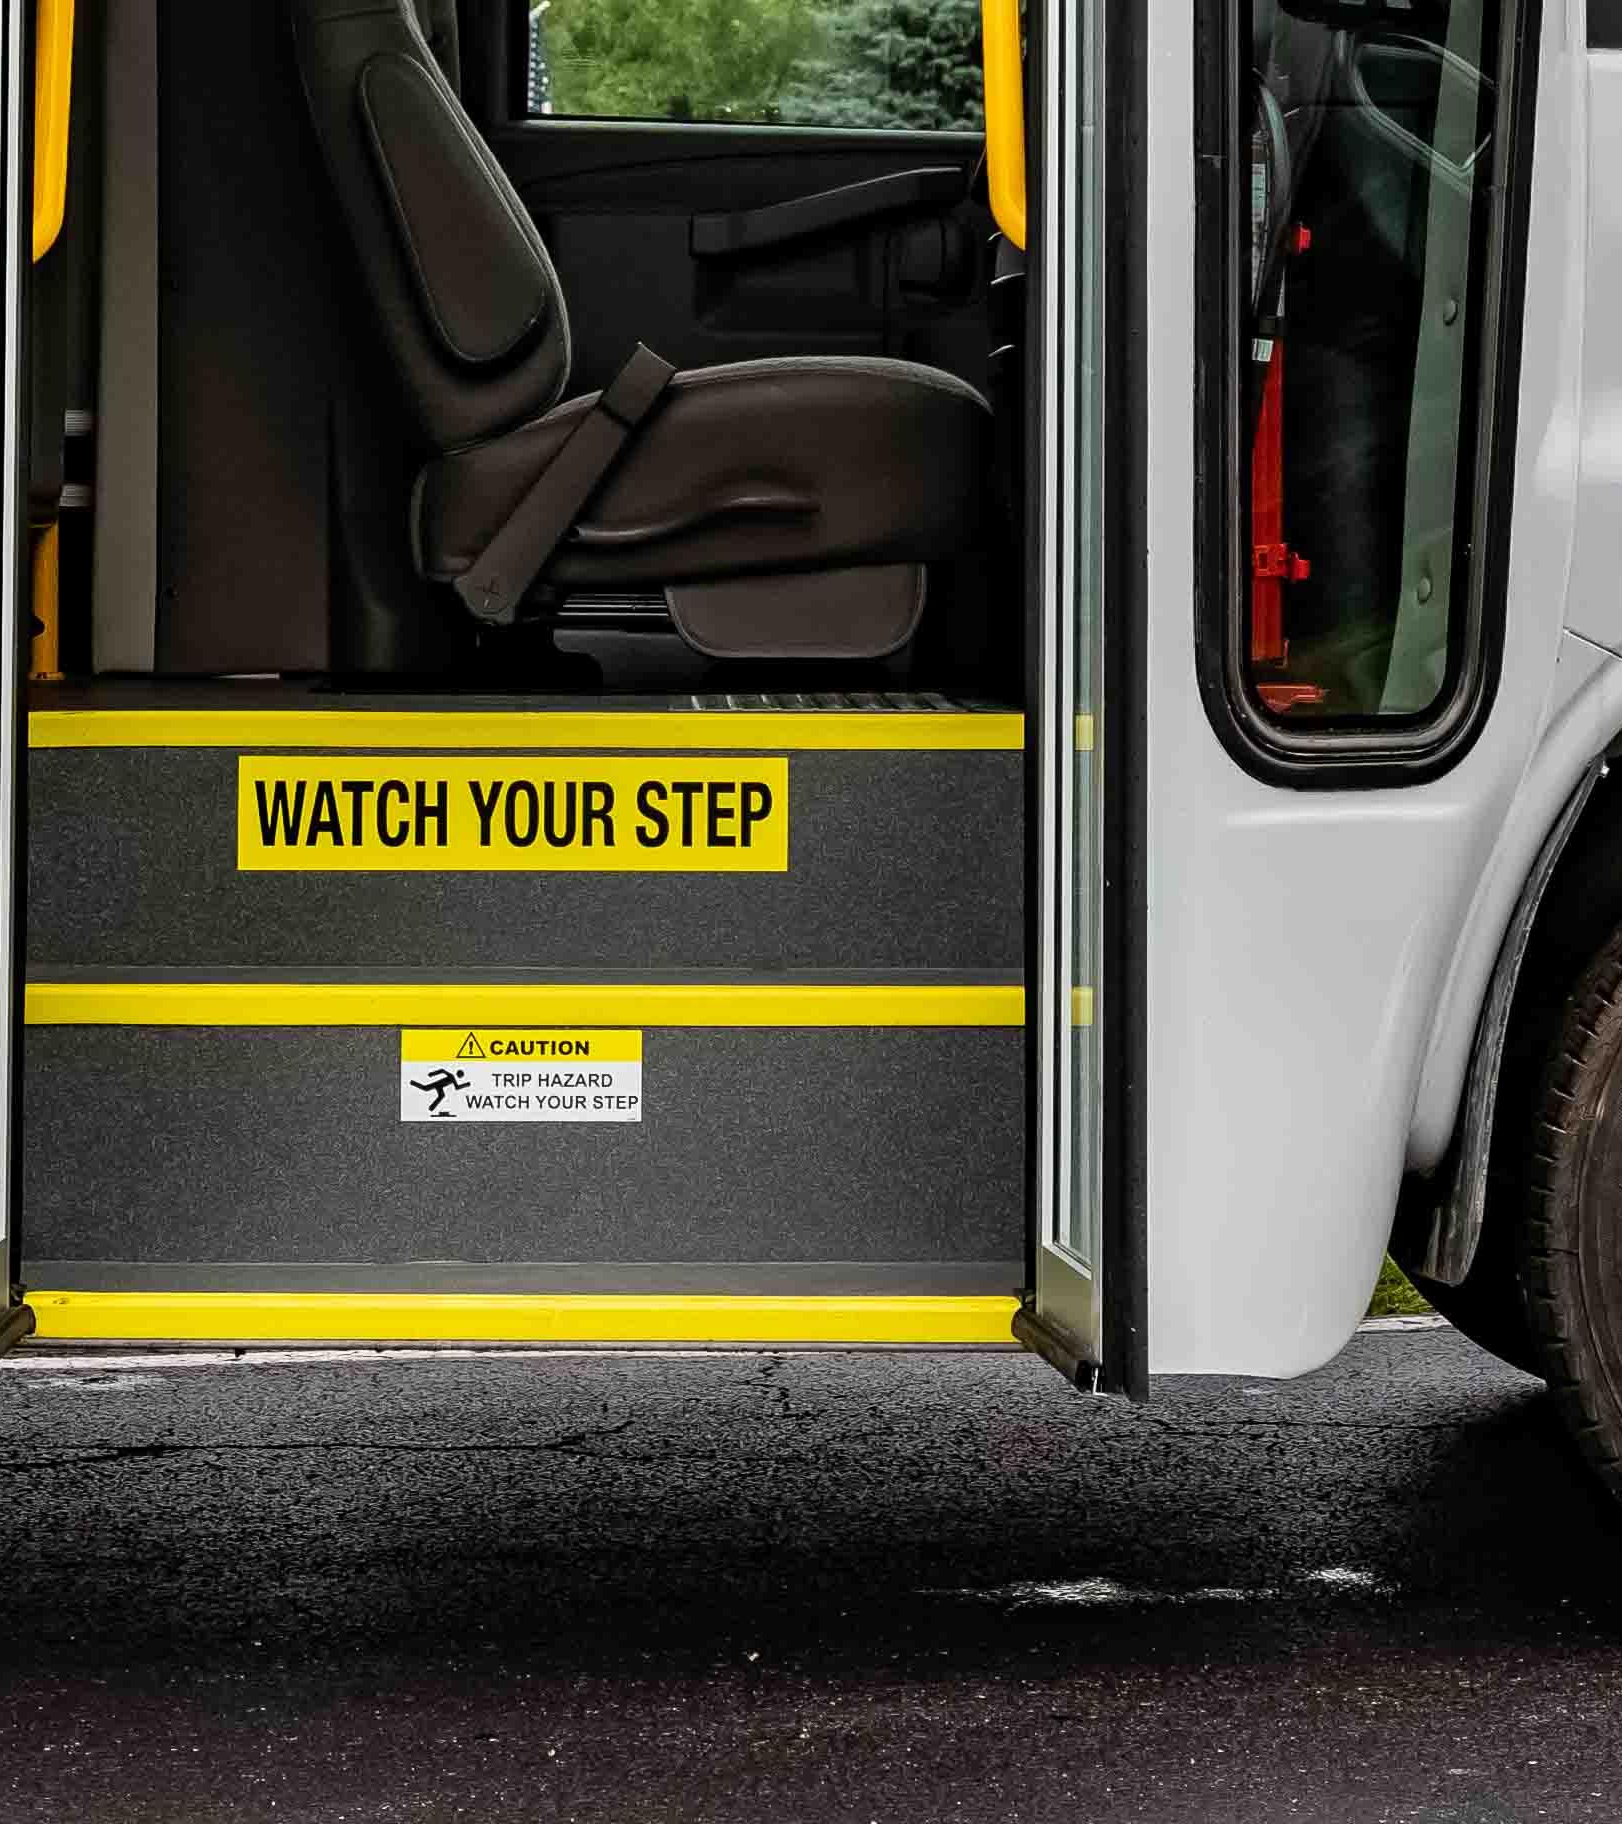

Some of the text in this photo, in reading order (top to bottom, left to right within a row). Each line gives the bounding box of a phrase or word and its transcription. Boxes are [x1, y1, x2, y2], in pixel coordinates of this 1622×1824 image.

[254, 779, 774, 848] WATCH YOUR STEP
[489, 1040, 591, 1057] CAUTION
[491, 1073, 613, 1088] TRIP HAZARD
[465, 1095, 639, 1110] WATCH YOUR STEP
